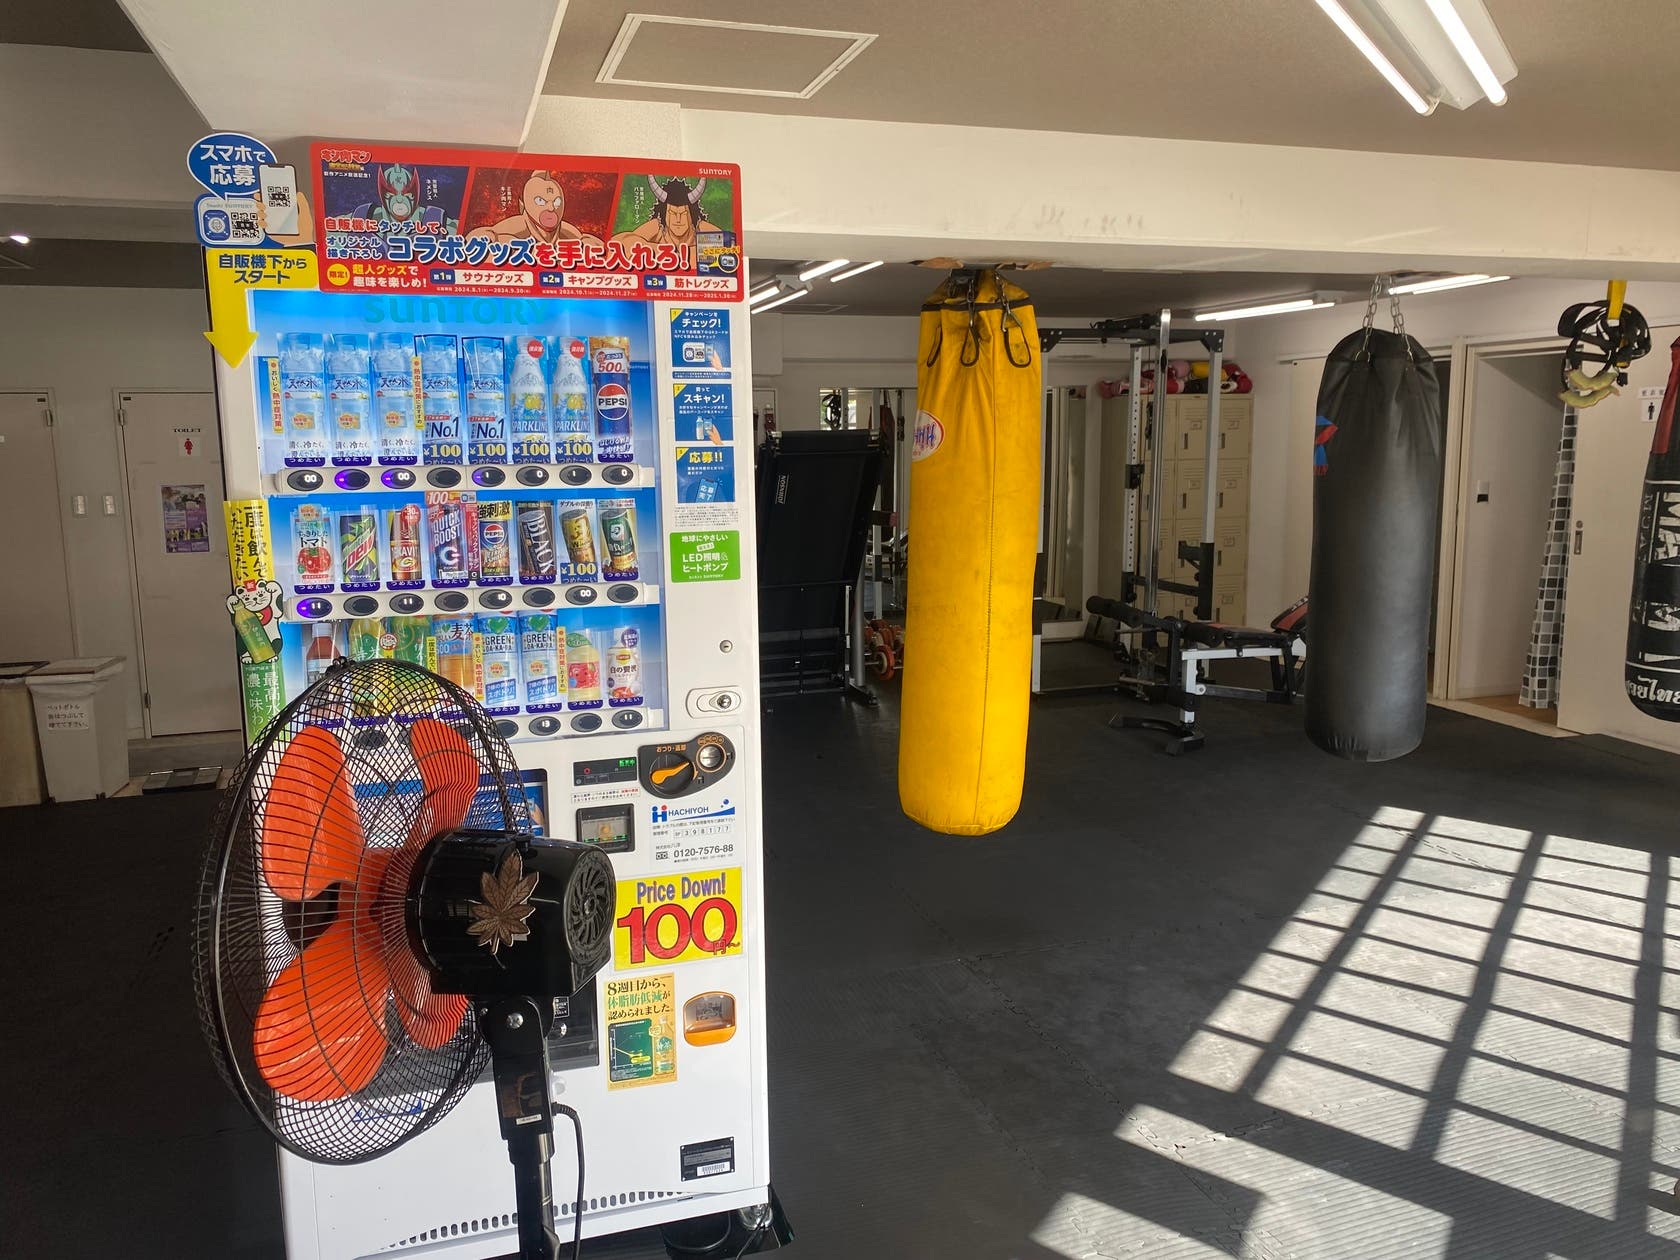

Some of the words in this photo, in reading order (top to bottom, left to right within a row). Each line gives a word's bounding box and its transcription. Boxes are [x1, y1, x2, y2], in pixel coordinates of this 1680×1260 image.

[200, 145, 266, 163] スマホで
[210, 164, 256, 186] 応募
[699, 168, 732, 176] SUNTORY
[324, 217, 447, 235] 自販機にタッチして、
[327, 236, 381, 248] オリジナル
[327, 248, 382, 260] 描き下ろし
[219, 254, 307, 269] 自販機下から
[352, 264, 419, 276] 超人グッズで
[234, 270, 290, 284] スタート
[353, 276, 427, 288] 趣味を楽しめ!
[462, 272, 524, 283] サウナグッズ
[568, 275, 632, 287] キャンプグッズ
[674, 278, 729, 289] 筋トレグッズ
[682, 318, 721, 328] チェック!
[599, 362, 622, 373] 500
[288, 378, 318, 390] 天然水
[335, 379, 365, 390] 天然水
[380, 377, 410, 388] 天然水
[426, 378, 450, 390] 天然水
[474, 379, 499, 391] 天然水
[598, 397, 628, 407] PEPSI
[684, 394, 724, 404] スキャン!
[431, 416, 459, 438] No.1
[477, 417, 505, 439] No.1
[423, 444, 462, 458] ¥100
[469, 443, 506, 457] ¥100
[514, 442, 550, 456] ¥100
[556, 442, 592, 456] ¥100
[433, 509, 460, 533] QUICK
[434, 524, 461, 548] BOOST
[682, 534, 728, 543] 地球にやさしい
[300, 537, 328, 548] トマト
[526, 516, 555, 574] BLACK
[561, 563, 597, 577] ¥100
[683, 562, 728, 573] ヒートポンプ
[451, 622, 474, 641] 麦茶
[485, 635, 512, 646] GREEN
[526, 634, 552, 644] GREEN
[668, 806, 709, 817] HACHIYOH
[673, 844, 734, 858] 0120-7576-88
[636, 881, 676, 905] Price
[681, 872, 726, 899] Down!
[617, 897, 738, 964] 100
[608, 978, 667, 996] 8週目から、
[608, 991, 671, 1010] 体脂肪低減が
